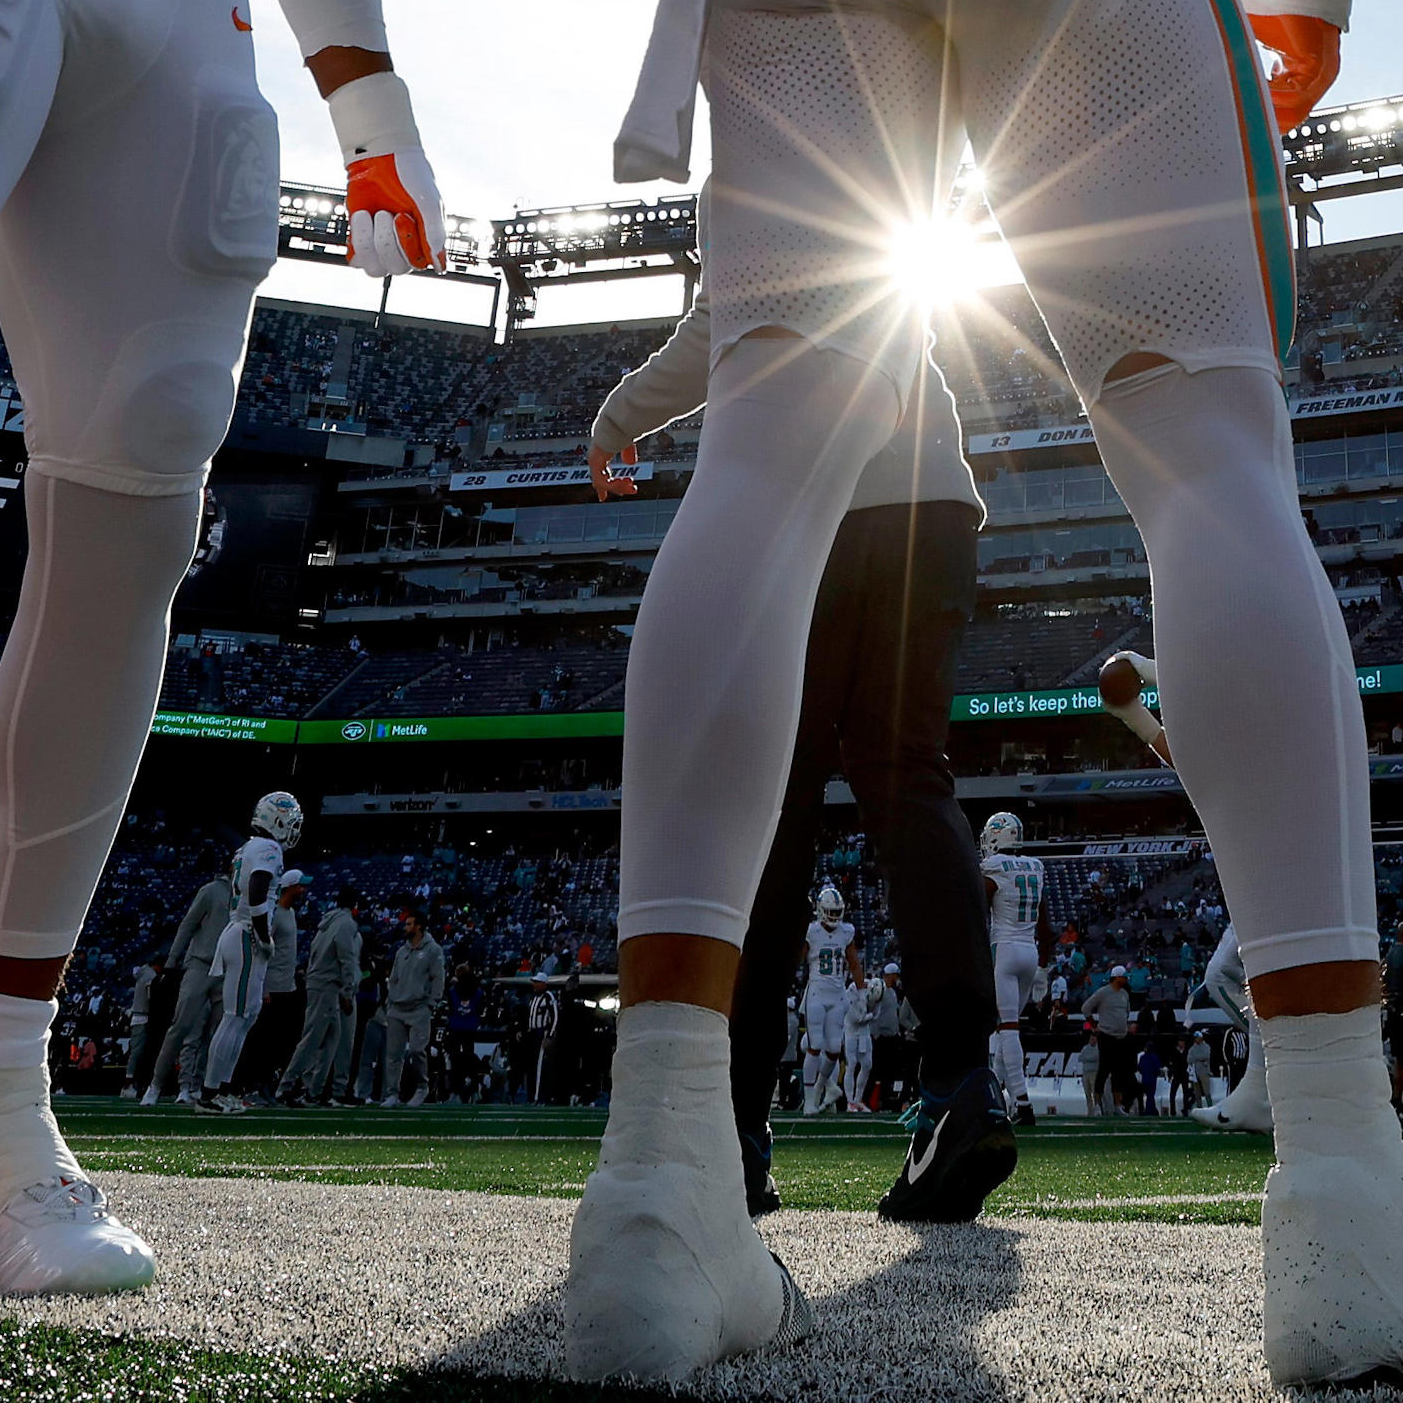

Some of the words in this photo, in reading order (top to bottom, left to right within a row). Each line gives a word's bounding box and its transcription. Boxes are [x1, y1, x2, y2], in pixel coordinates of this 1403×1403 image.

[1296, 392, 1390, 414] FREEMAN
[991, 436, 1011, 447] 13
[1038, 429, 1078, 443] DON
[462, 476, 487, 486] 28
[506, 470, 569, 484] CURTIS
[570, 466, 640, 481] MTIN
[969, 698, 990, 715] So
[993, 695, 1025, 714] let's
[1029, 694, 1068, 714] keep
[231, 718, 241, 727] of
[250, 720, 267, 729] and
[391, 724, 428, 736] MetLife
[161, 725, 199, 738] Company
[232, 729, 242, 739] of
[1104, 777, 1175, 789] MetLife
[1082, 844, 1130, 856] NEW
[1132, 842, 1175, 854] YORK
[1014, 874, 1039, 923] 11
